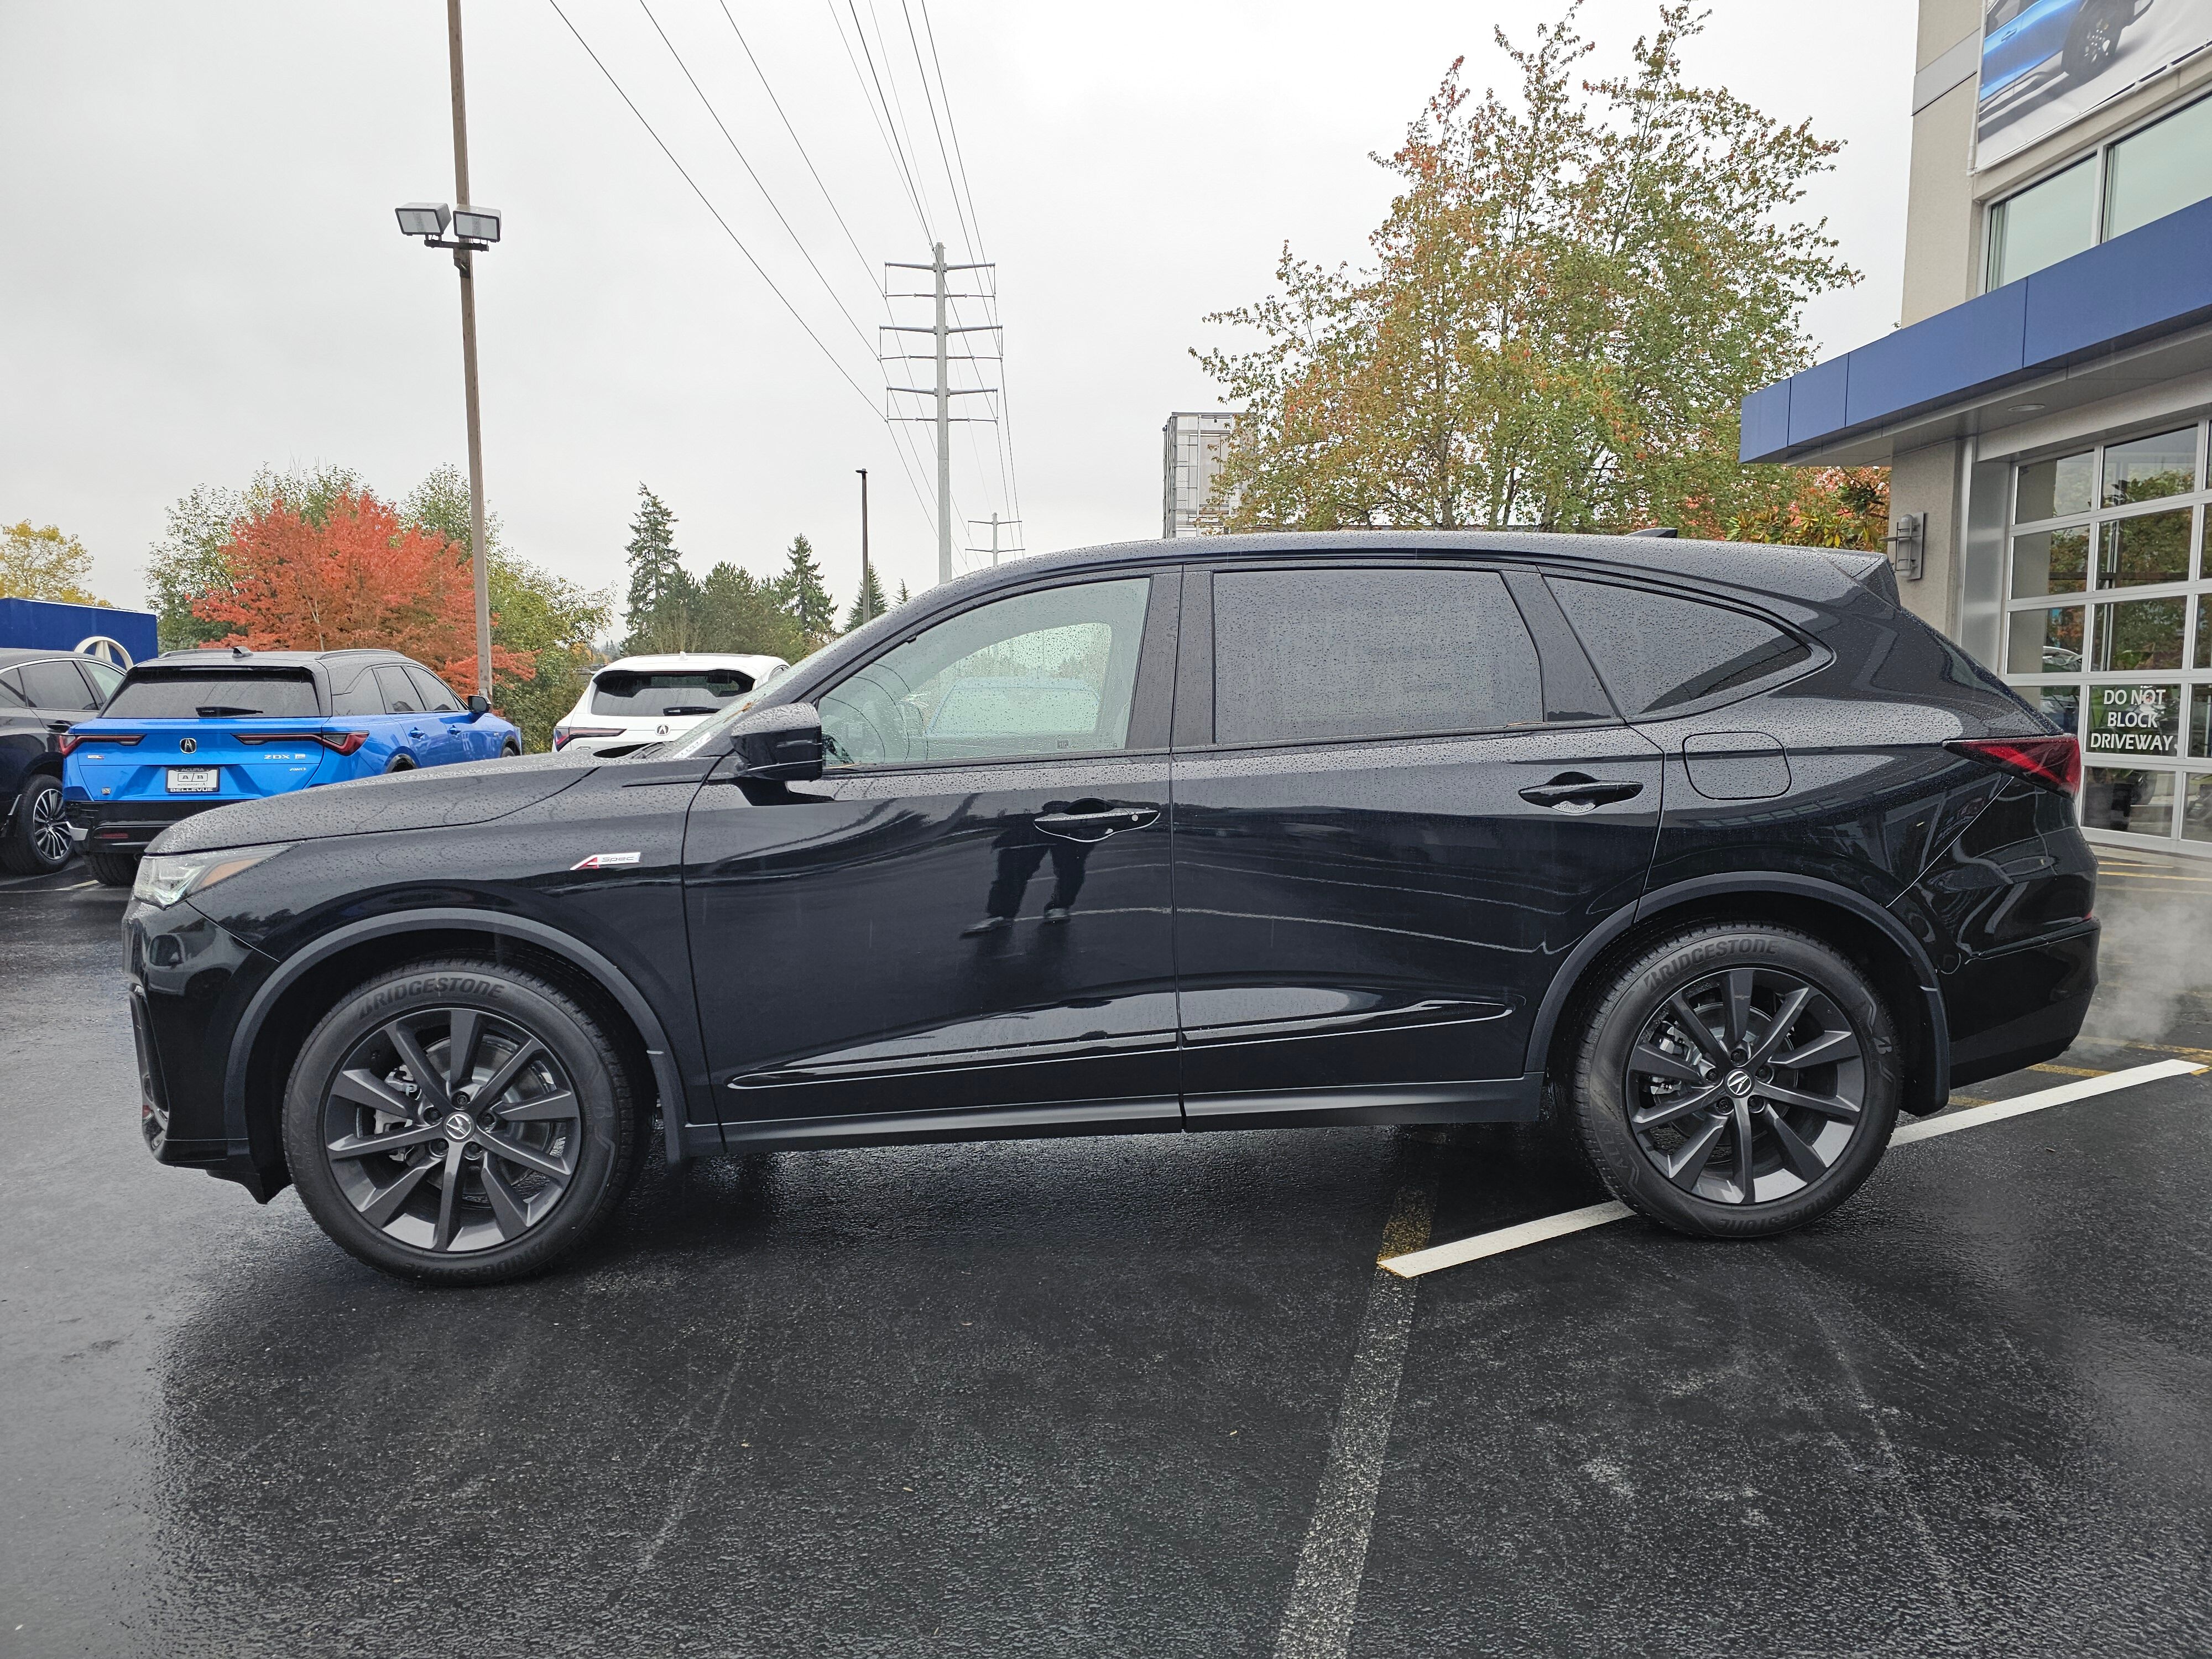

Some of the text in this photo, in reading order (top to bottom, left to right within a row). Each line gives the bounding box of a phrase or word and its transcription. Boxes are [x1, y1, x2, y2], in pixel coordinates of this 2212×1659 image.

[2104, 689, 2166, 705] DO NOT
[2107, 712, 2158, 728] BLOCK
[2090, 733, 2174, 751] DRIVEWAY
[1643, 938, 1778, 994] BRIDGESTONE
[359, 977, 505, 1020] BRIDGESTONE
